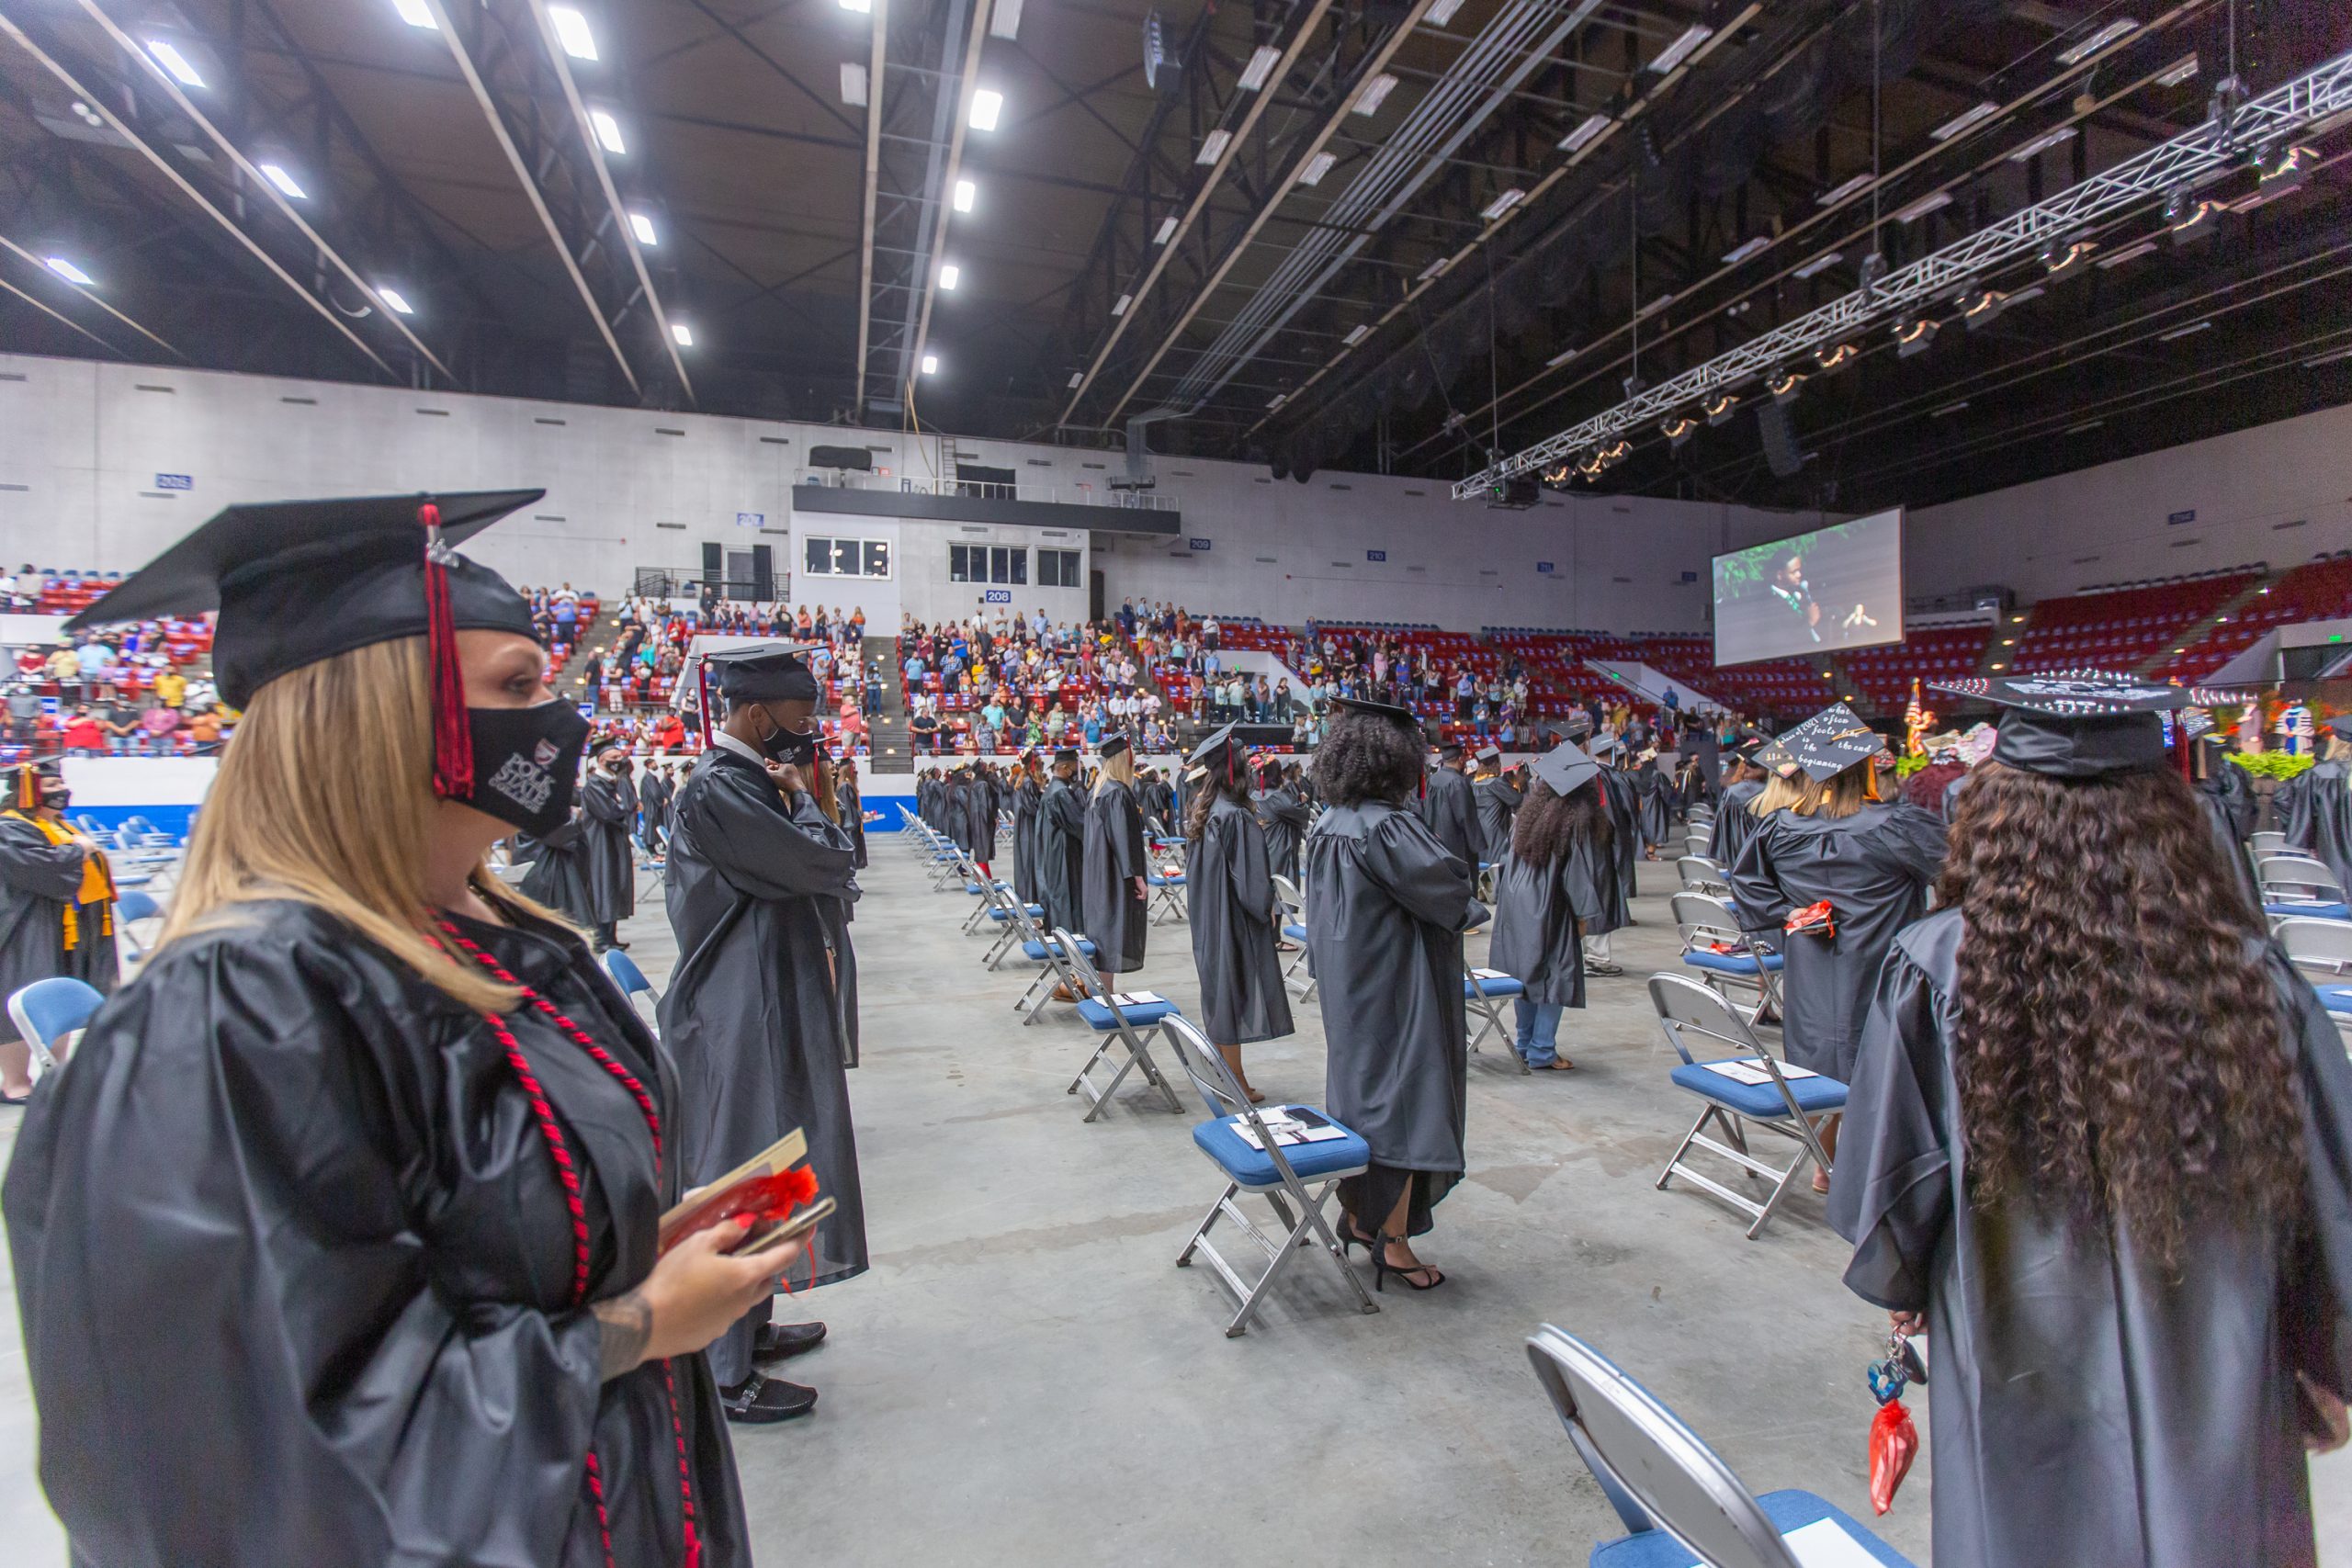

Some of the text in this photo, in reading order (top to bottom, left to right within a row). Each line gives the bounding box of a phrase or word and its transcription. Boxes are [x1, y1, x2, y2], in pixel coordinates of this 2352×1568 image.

[1192, 539, 1209, 549] 209
[1369, 551, 1384, 560] 210
[988, 591, 1009, 602] 208
[1828, 705, 1850, 715] what
[1823, 714, 1849, 726] often
[1812, 725, 1836, 735] feels
[1804, 742, 1818, 752] the
[1838, 740, 1872, 752] the end
[1798, 753, 1843, 773] beginning
[504, 752, 557, 788] POLK
[494, 764, 551, 806] STATE
